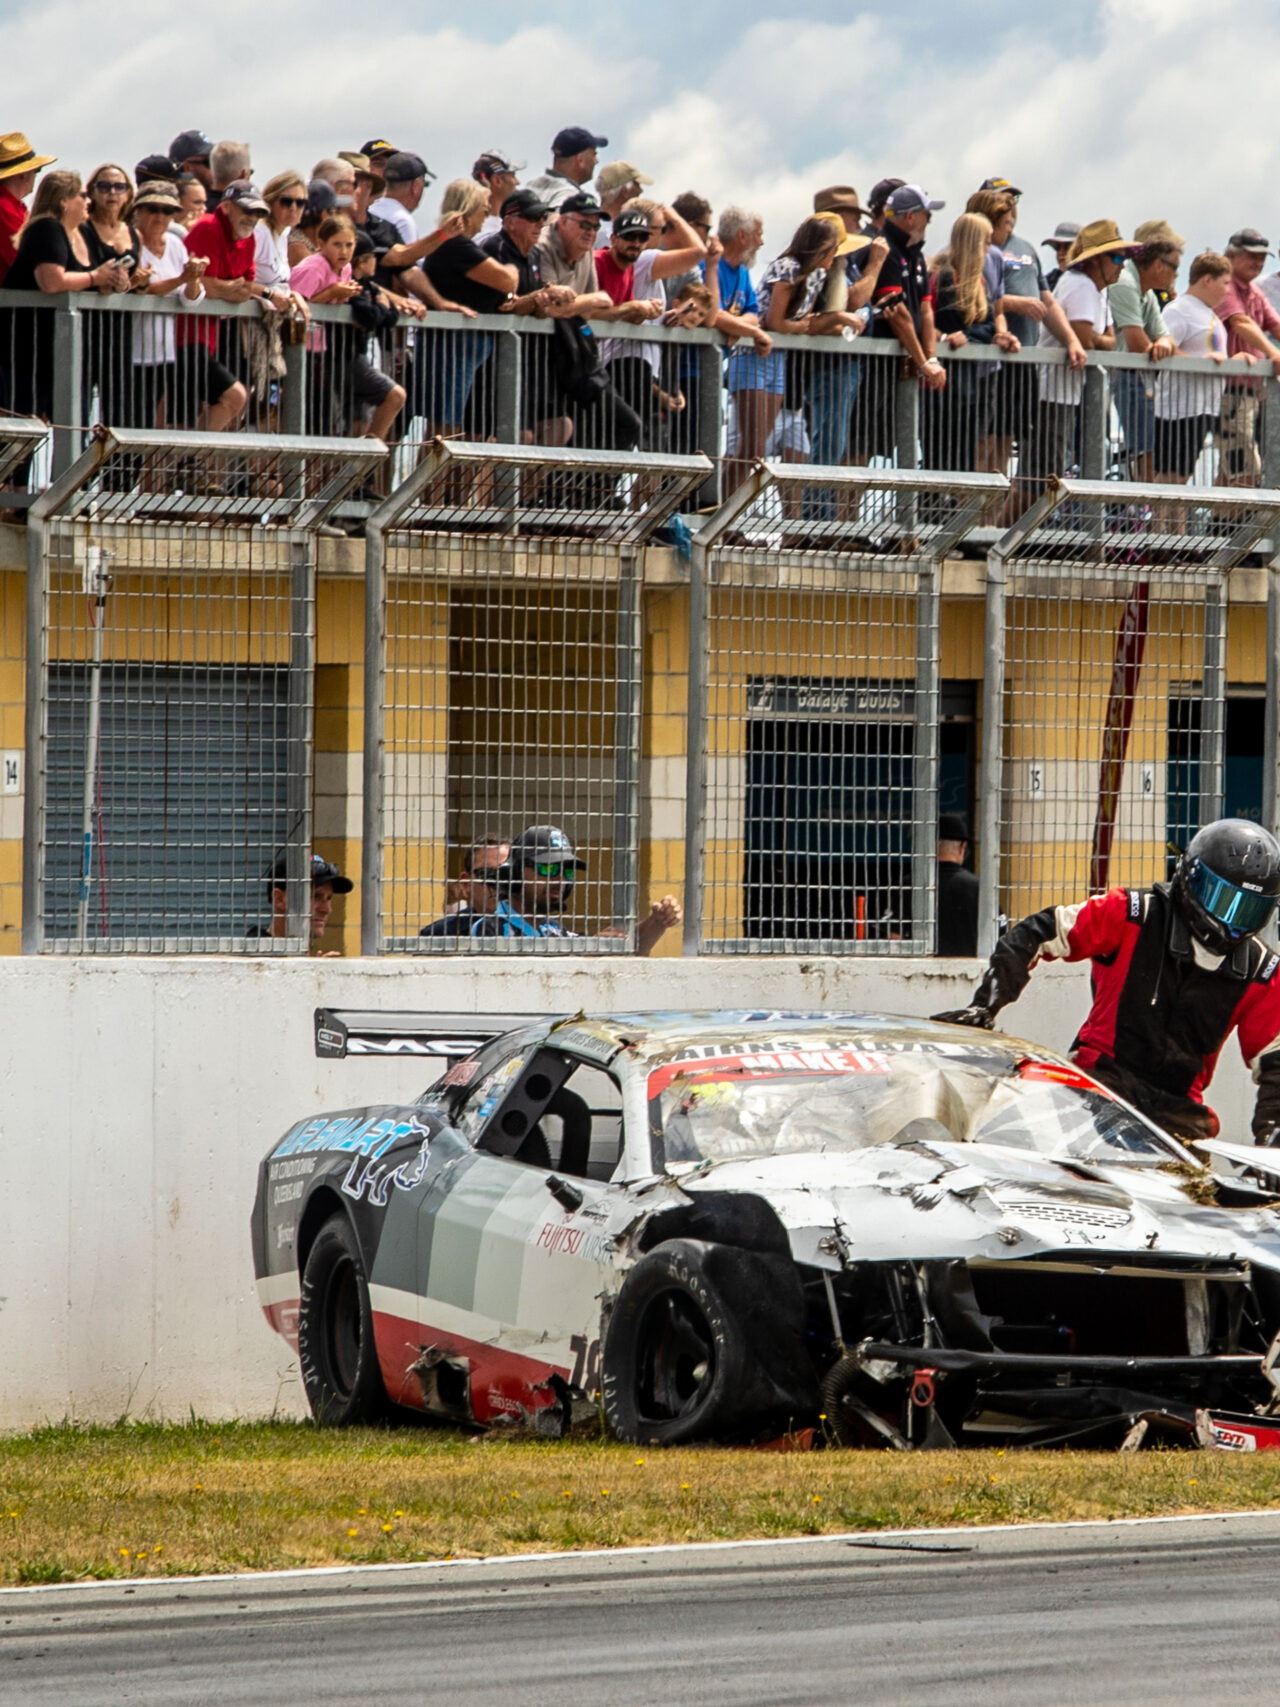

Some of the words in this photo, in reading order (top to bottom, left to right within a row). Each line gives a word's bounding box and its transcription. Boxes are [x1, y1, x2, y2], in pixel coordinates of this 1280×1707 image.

[6, 759, 18, 785] 14
[664, 1041, 803, 1063] AIRNS
[740, 1053, 855, 1072] MAKE
[536, 1222, 586, 1258] FUJITSU
